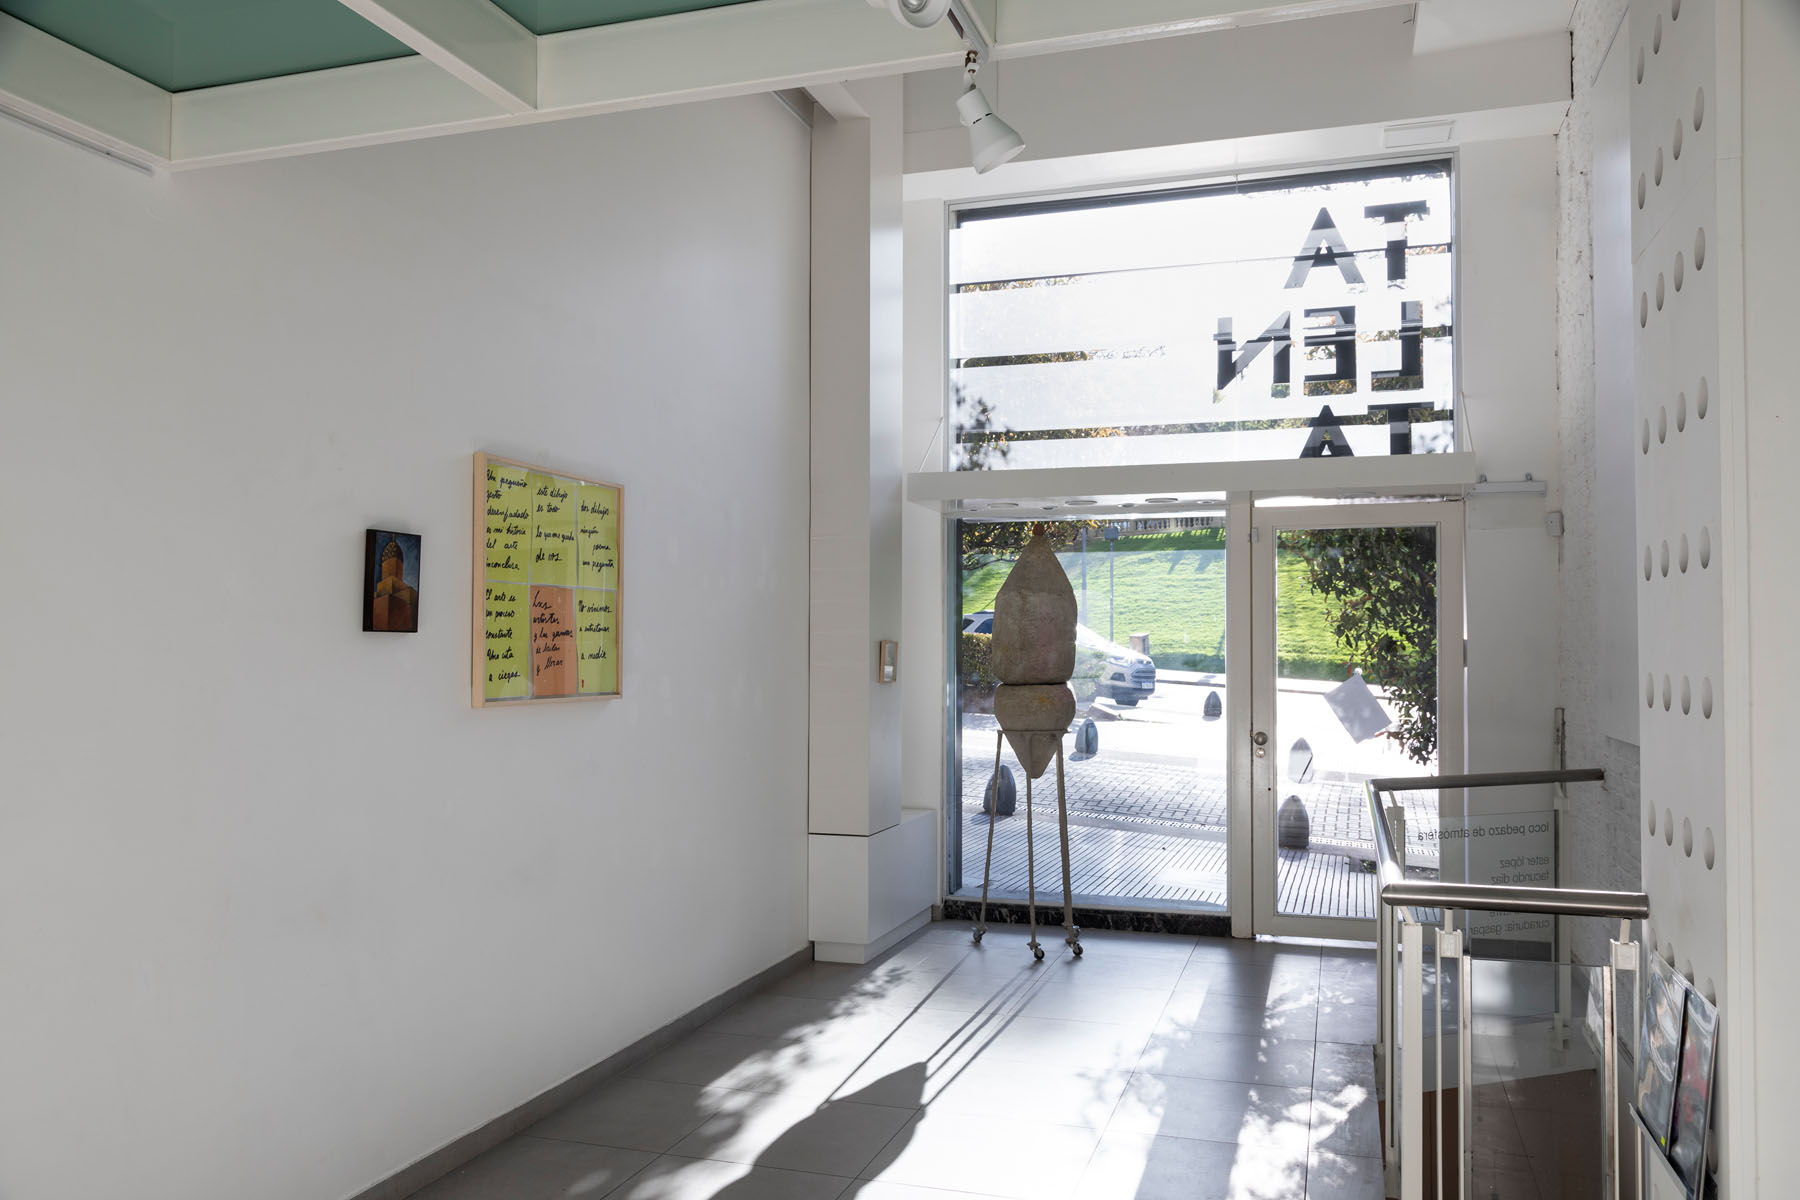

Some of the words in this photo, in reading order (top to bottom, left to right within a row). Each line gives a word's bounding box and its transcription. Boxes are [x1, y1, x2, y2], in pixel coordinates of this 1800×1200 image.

[550, 488, 568, 502] dibujo
[506, 522, 526, 536] historia
[504, 541, 518, 550] arte
